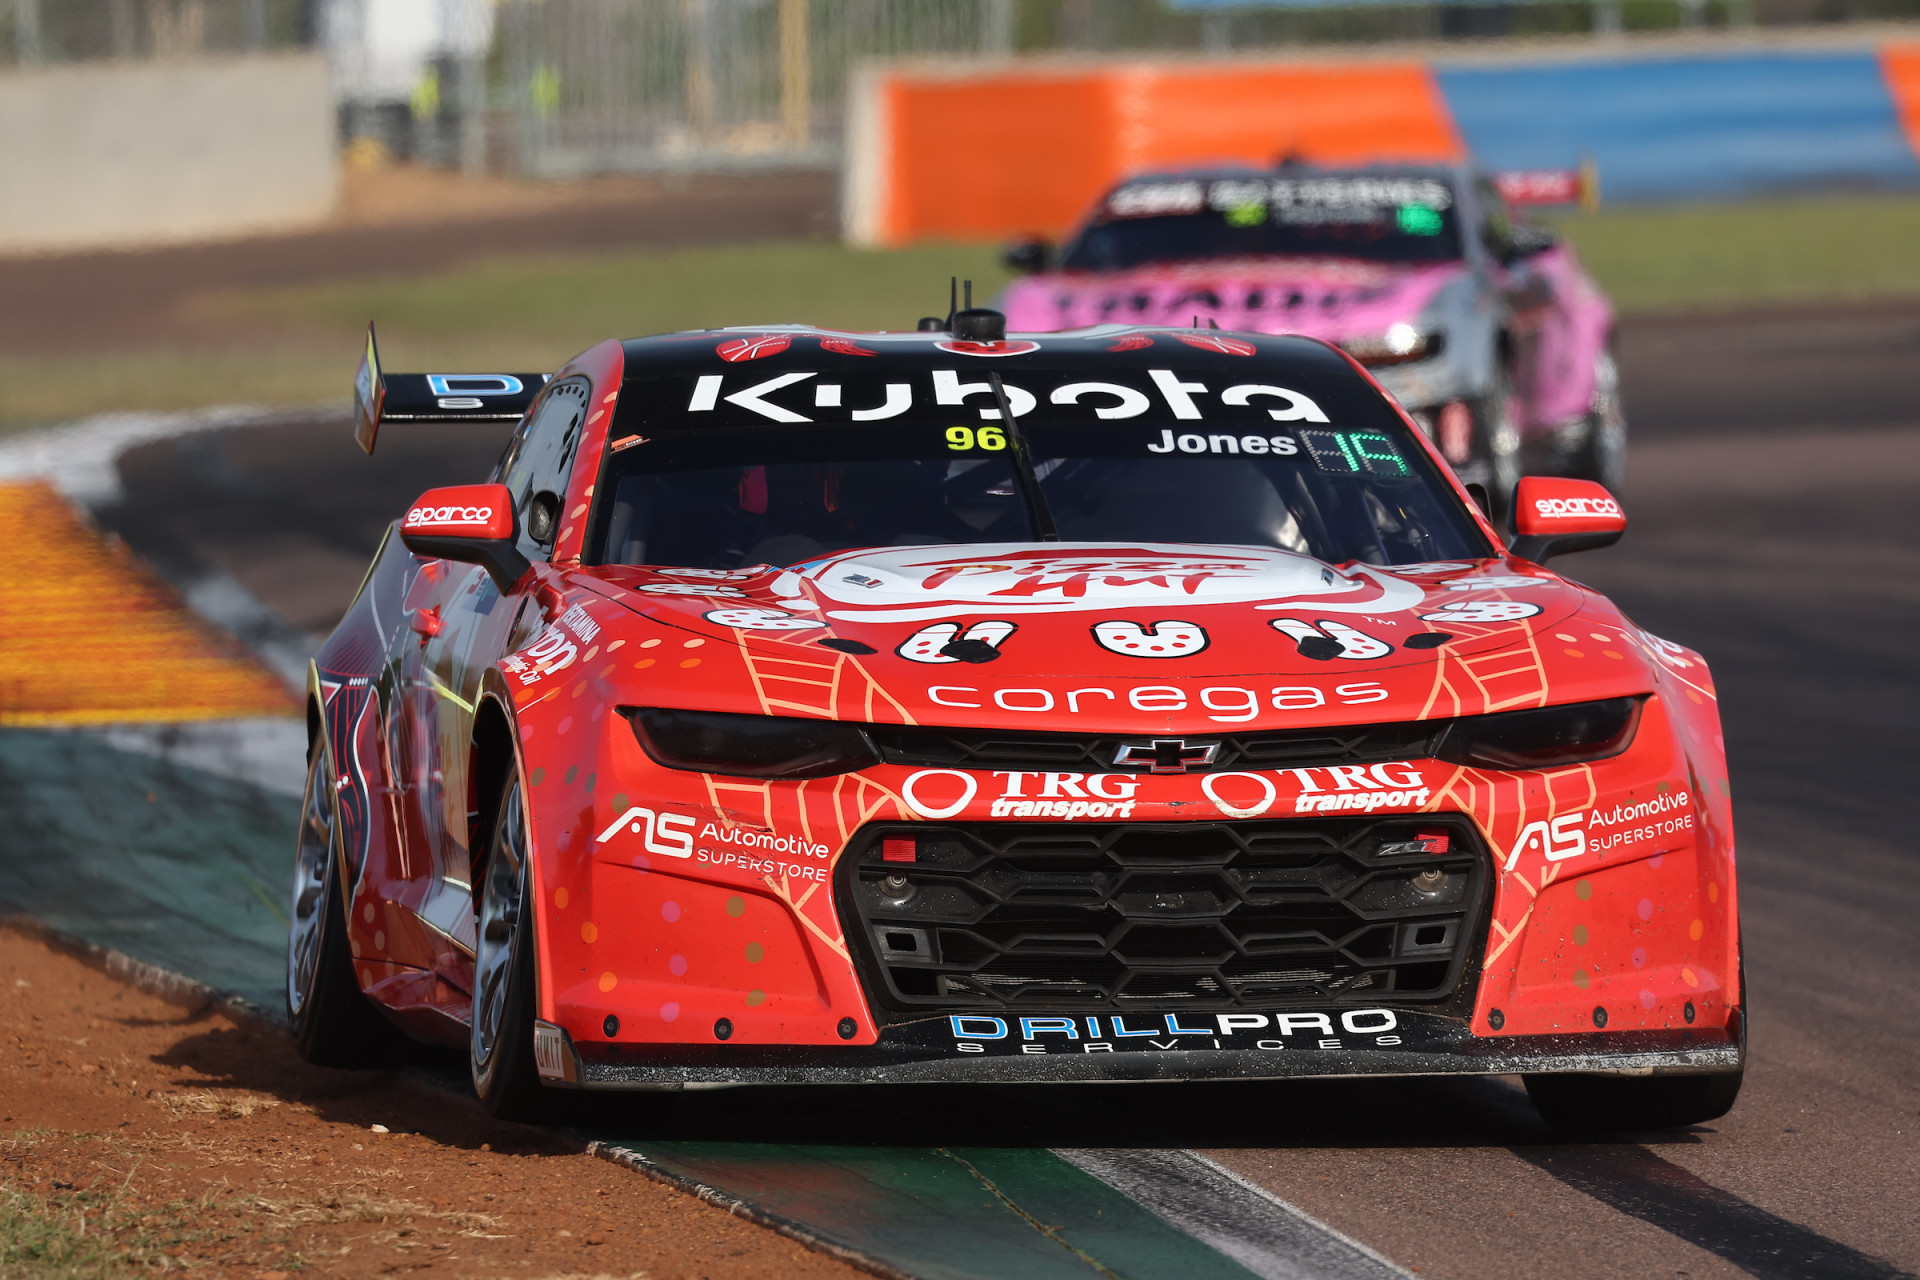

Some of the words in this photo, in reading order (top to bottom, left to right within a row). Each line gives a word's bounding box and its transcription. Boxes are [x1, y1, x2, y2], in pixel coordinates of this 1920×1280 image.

[688, 370, 1331, 423] Kubota
[945, 426, 1007, 451] 96
[1147, 429, 1299, 455] Jones
[406, 505, 493, 527] sparco
[1535, 497, 1620, 518] sparco
[922, 559, 1262, 590] Pizza
[986, 572, 1254, 598] Hut
[518, 670, 543, 686] Oil
[927, 682, 1388, 722] coregas
[993, 770, 1142, 799] TRG
[1275, 761, 1424, 793] TRG
[989, 796, 1136, 820] transport
[1294, 787, 1430, 813] transport
[595, 806, 697, 859] AS
[699, 822, 830, 859] Automotive
[1503, 812, 1586, 872] AS
[1588, 791, 1689, 830] Automotive
[1589, 814, 1693, 852] SUPERSTORE
[1377, 839, 1436, 857] ZL1
[697, 849, 829, 883] SUPERSTORE
[948, 1008, 1398, 1041] DRILLPRO
[956, 1035, 1403, 1055] SERVICES
